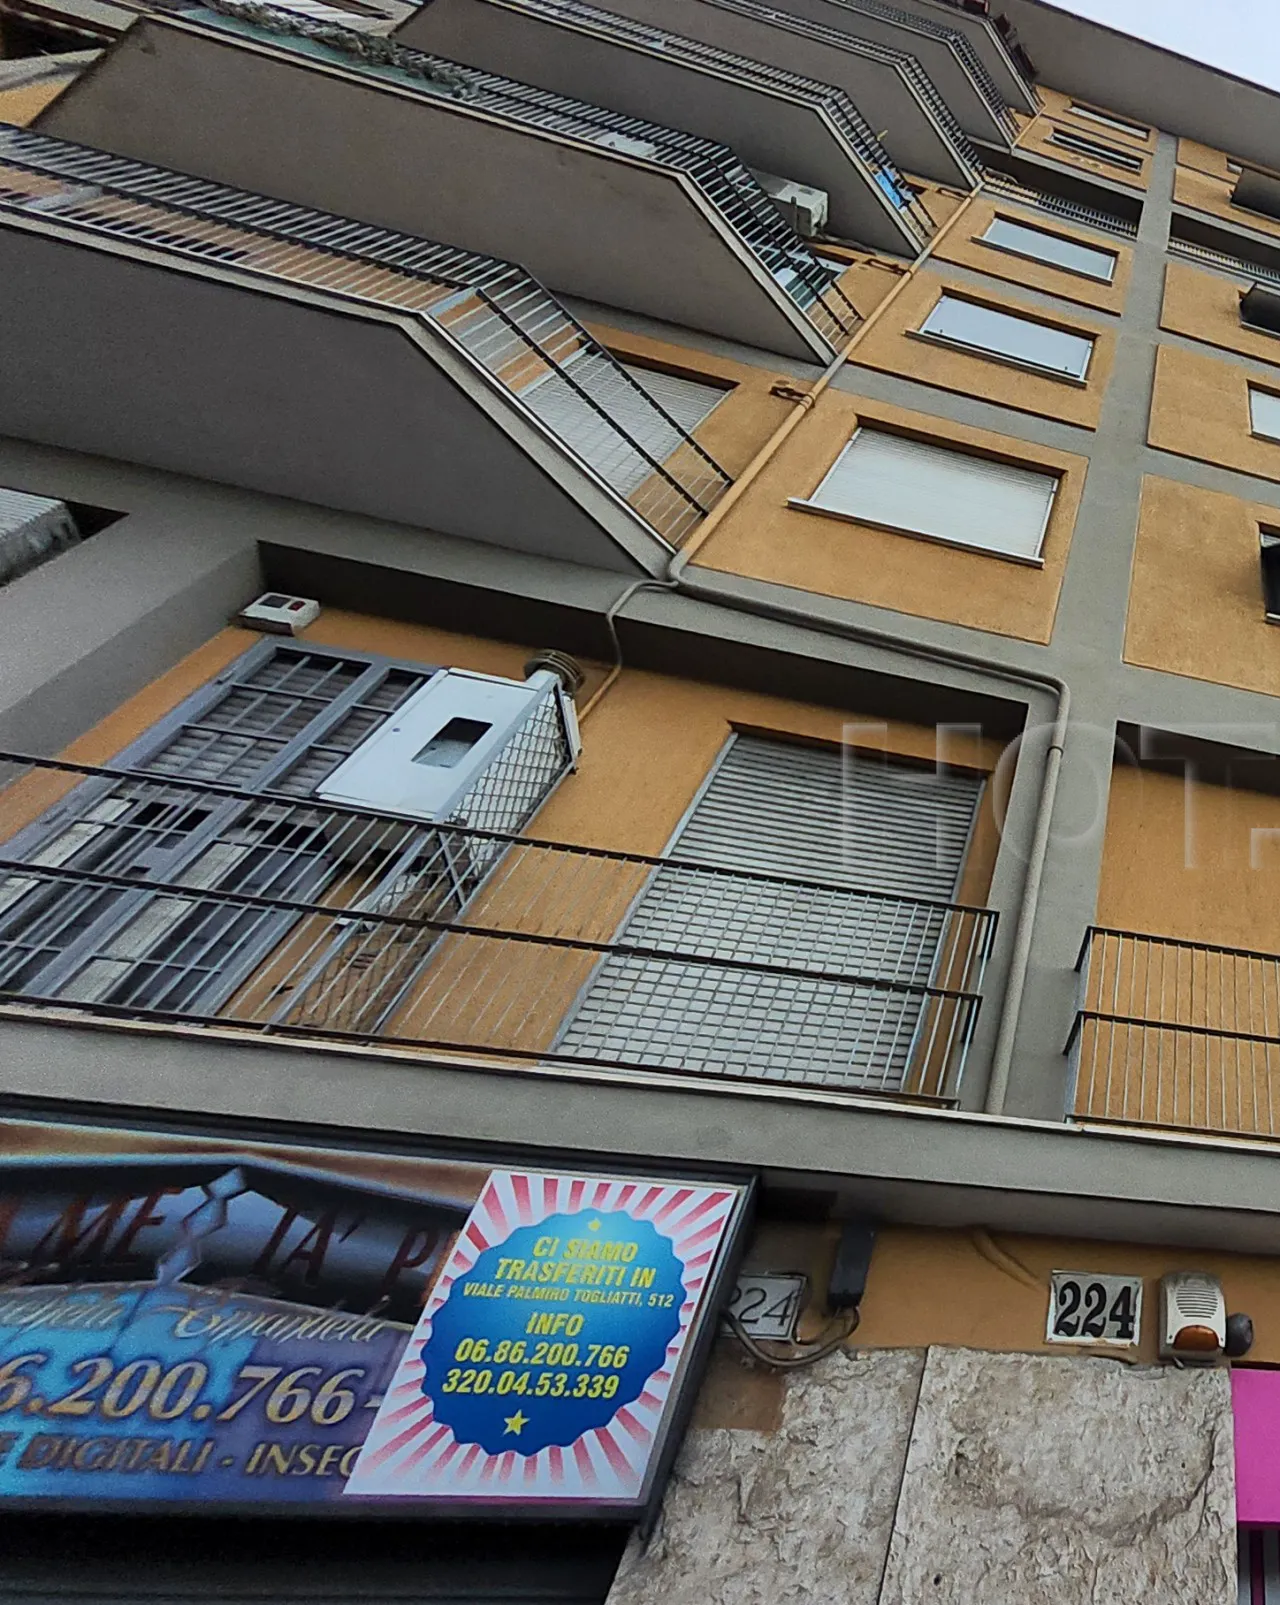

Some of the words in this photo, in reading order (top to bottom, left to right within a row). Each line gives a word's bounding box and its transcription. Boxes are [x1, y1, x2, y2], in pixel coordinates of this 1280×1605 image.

[532, 1236, 560, 1257] CI
[563, 1239, 639, 1262] SIAMO
[494, 1258, 627, 1286] TRASFERITI
[629, 1267, 657, 1288] IN
[463, 1282, 505, 1298] VIALE
[506, 1285, 570, 1302] PALMIRO
[573, 1290, 644, 1307] TOGLIATTI,
[647, 1293, 675, 1308] 512
[1053, 1281, 1134, 1339] 224
[525, 1311, 585, 1337] INFO
[453, 1337, 631, 1369] 06.86.200.766
[441, 1367, 620, 1399] 320.04.53.339
[17, 1432, 212, 1473] DIGITALI
